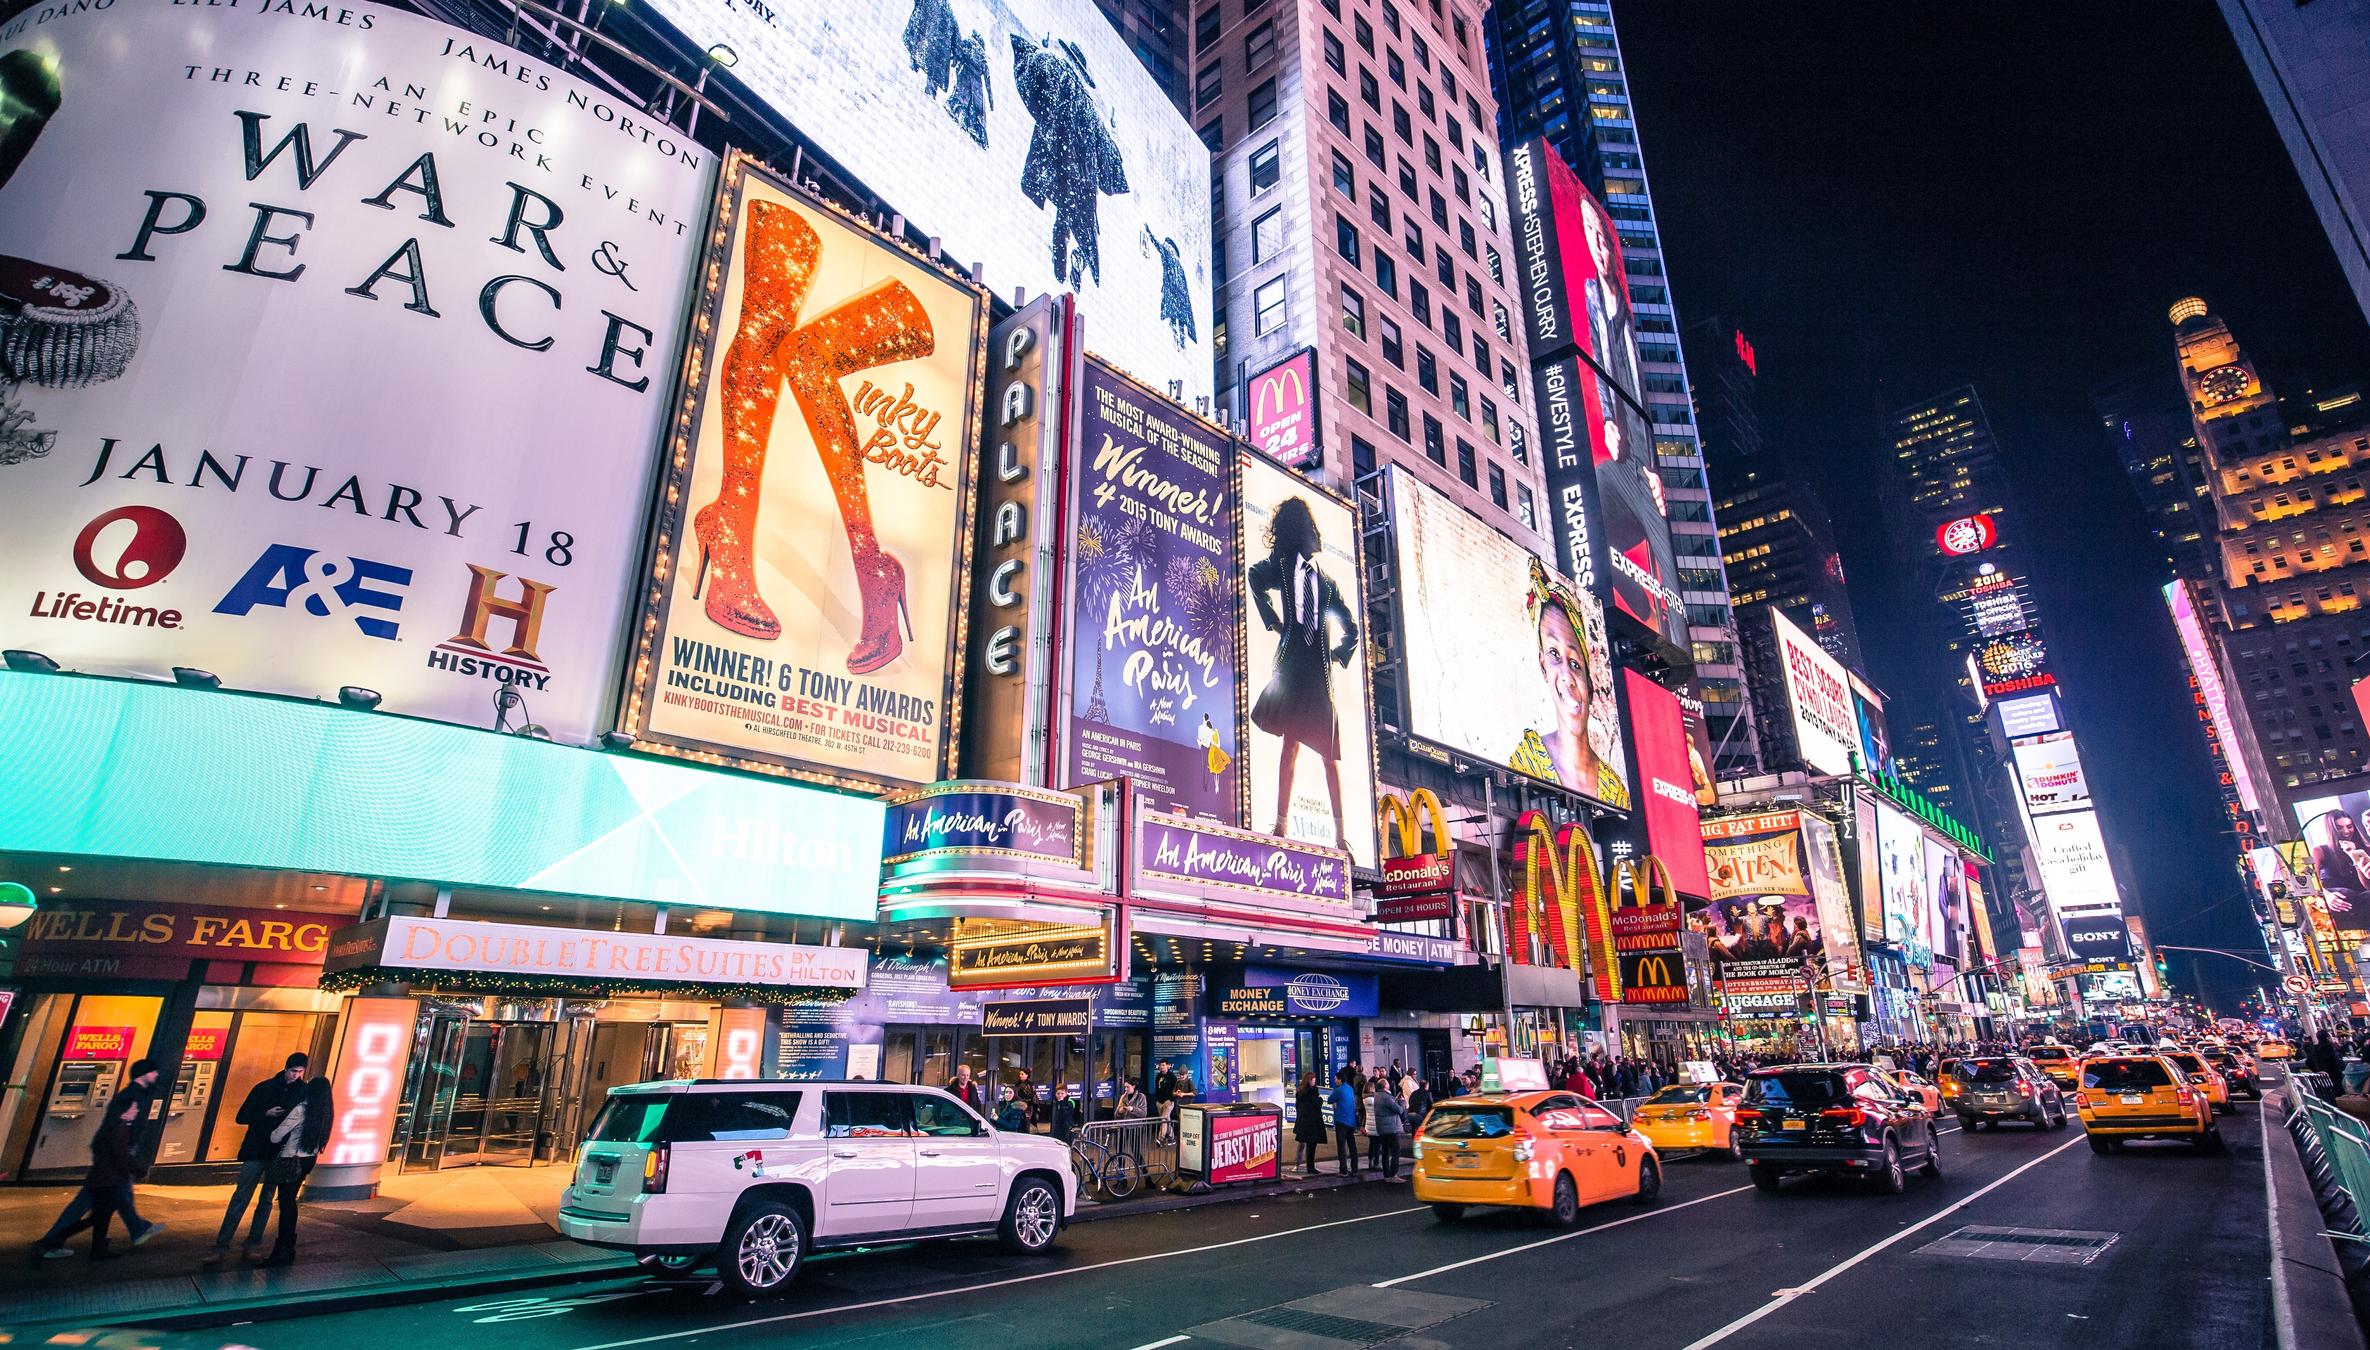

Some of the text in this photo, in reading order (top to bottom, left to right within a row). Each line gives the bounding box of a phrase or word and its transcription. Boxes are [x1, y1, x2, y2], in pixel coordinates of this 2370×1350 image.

[258, 0, 376, 30] JAMES
[374, 75, 546, 145] AN EPIC
[441, 38, 700, 170] JAMES NORTON
[184, 65, 688, 236] THREE-NETWORK EVENT
[232, 109, 639, 292] WAR &
[115, 189, 654, 394] PEACE
[1534, 288, 1558, 340] CURRY
[1095, 386, 1115, 408] THE
[1117, 398, 1144, 422] MOST
[1146, 414, 1221, 465] AWARD-WINNING
[1260, 411, 1301, 438] OPEN
[1100, 404, 1145, 439] MUSICAL
[1146, 429, 1159, 446] OF
[1161, 436, 1180, 457] THE
[1180, 447, 1218, 478] SEASON!
[1266, 426, 1298, 455] 24
[862, 428, 952, 491] Boots
[1093, 433, 1223, 526] Winner!
[1545, 364, 1595, 588] #GIVESTYLE EXPRESS
[79, 437, 575, 567] JANUARY 18
[985, 325, 1036, 677] PALACE
[1093, 481, 1222, 556] 4 2015 TONY AWARDS
[212, 543, 414, 641] A&E
[1127, 563, 1160, 614] An
[1969, 580, 2013, 595] TOSHIBA
[29, 591, 183, 629] Lifetime
[1974, 594, 2017, 609] TOSHIBA
[1103, 589, 1219, 688] American
[1162, 647, 1173, 658] in
[1786, 639, 1815, 686] BEST
[427, 649, 551, 692] HISTORY
[1999, 661, 2033, 674] 2016
[673, 636, 934, 726] WINNER! 6 TONY AWARDS
[1123, 650, 1198, 710] Paris
[1983, 674, 2056, 695] TOSHIBA
[667, 670, 932, 743] INCLUDING BEST MUSICAL
[1150, 696, 1173, 711] A New
[664, 691, 932, 759] KINKYBOOTSTHEMUSICAL.COM FOR TICKETS CALL 212-239-6200
[1150, 710, 1176, 727] Musical
[1800, 704, 1836, 737] 2013 TONY
[762, 727, 798, 741] HIRSCHFELD
[824, 739, 835, 749] 302
[1082, 729, 1091, 740] AN
[1091, 731, 1119, 746] AMERICAN
[1126, 739, 1142, 752] PARIS
[1081, 766, 1096, 778] CRAIG
[1097, 770, 1113, 780] LUCAS
[1082, 749, 1102, 762] GEORGE
[1102, 753, 1127, 768] GERSHWIN
[1143, 763, 1166, 776] GERSHWIN
[2039, 770, 2078, 783] DUNKIN'
[2041, 777, 2078, 788] DONUTS
[1152, 783, 1176, 795] WHEELDON
[2030, 793, 2058, 802] HOT
[904, 814, 919, 844] An
[920, 806, 999, 843] American
[1004, 808, 1043, 845] Paris
[1728, 820, 1755, 832] FAT
[710, 815, 850, 872] Hilton
[1705, 840, 1781, 857] OMETHING
[1154, 830, 1334, 893] An American in Paris New
[1312, 875, 1337, 894] Musical
[1386, 880, 1437, 892] Restaurant
[1379, 902, 1447, 915] OPEN 24 HOURS
[1612, 911, 1678, 926] McDonald's
[25, 911, 175, 944] WELLS
[186, 915, 330, 953] FARG
[1624, 922, 1668, 932] Restaurant
[2072, 931, 2120, 943] SONY
[792, 952, 816, 964] BY
[975, 943, 1048, 967] An American Paris
[1383, 940, 1425, 956] MONEY
[1430, 946, 1453, 959] ATM
[24, 958, 38, 973] 24
[79, 958, 121, 974] ATM
[790, 968, 856, 982] HILTON
[888, 957, 937, 974] Triumph!
[1039, 987, 1060, 998] Tony
[1230, 988, 1271, 1000] MONEY
[1288, 986, 1349, 999] MONEY EXCHANGE
[1720, 994, 1795, 1007] LUGGAGE
[1222, 1001, 1284, 1012] EXCHANGE
[985, 1009, 1087, 1028] Winner! 4 TONY AWARDS
[75, 1041, 119, 1050] FARGO
[77, 1033, 122, 1042] WELLS
[188, 1035, 215, 1043] ELLS
[1212, 1134, 1251, 1169] JERSEY
[1254, 1127, 1277, 1155] BOYS
